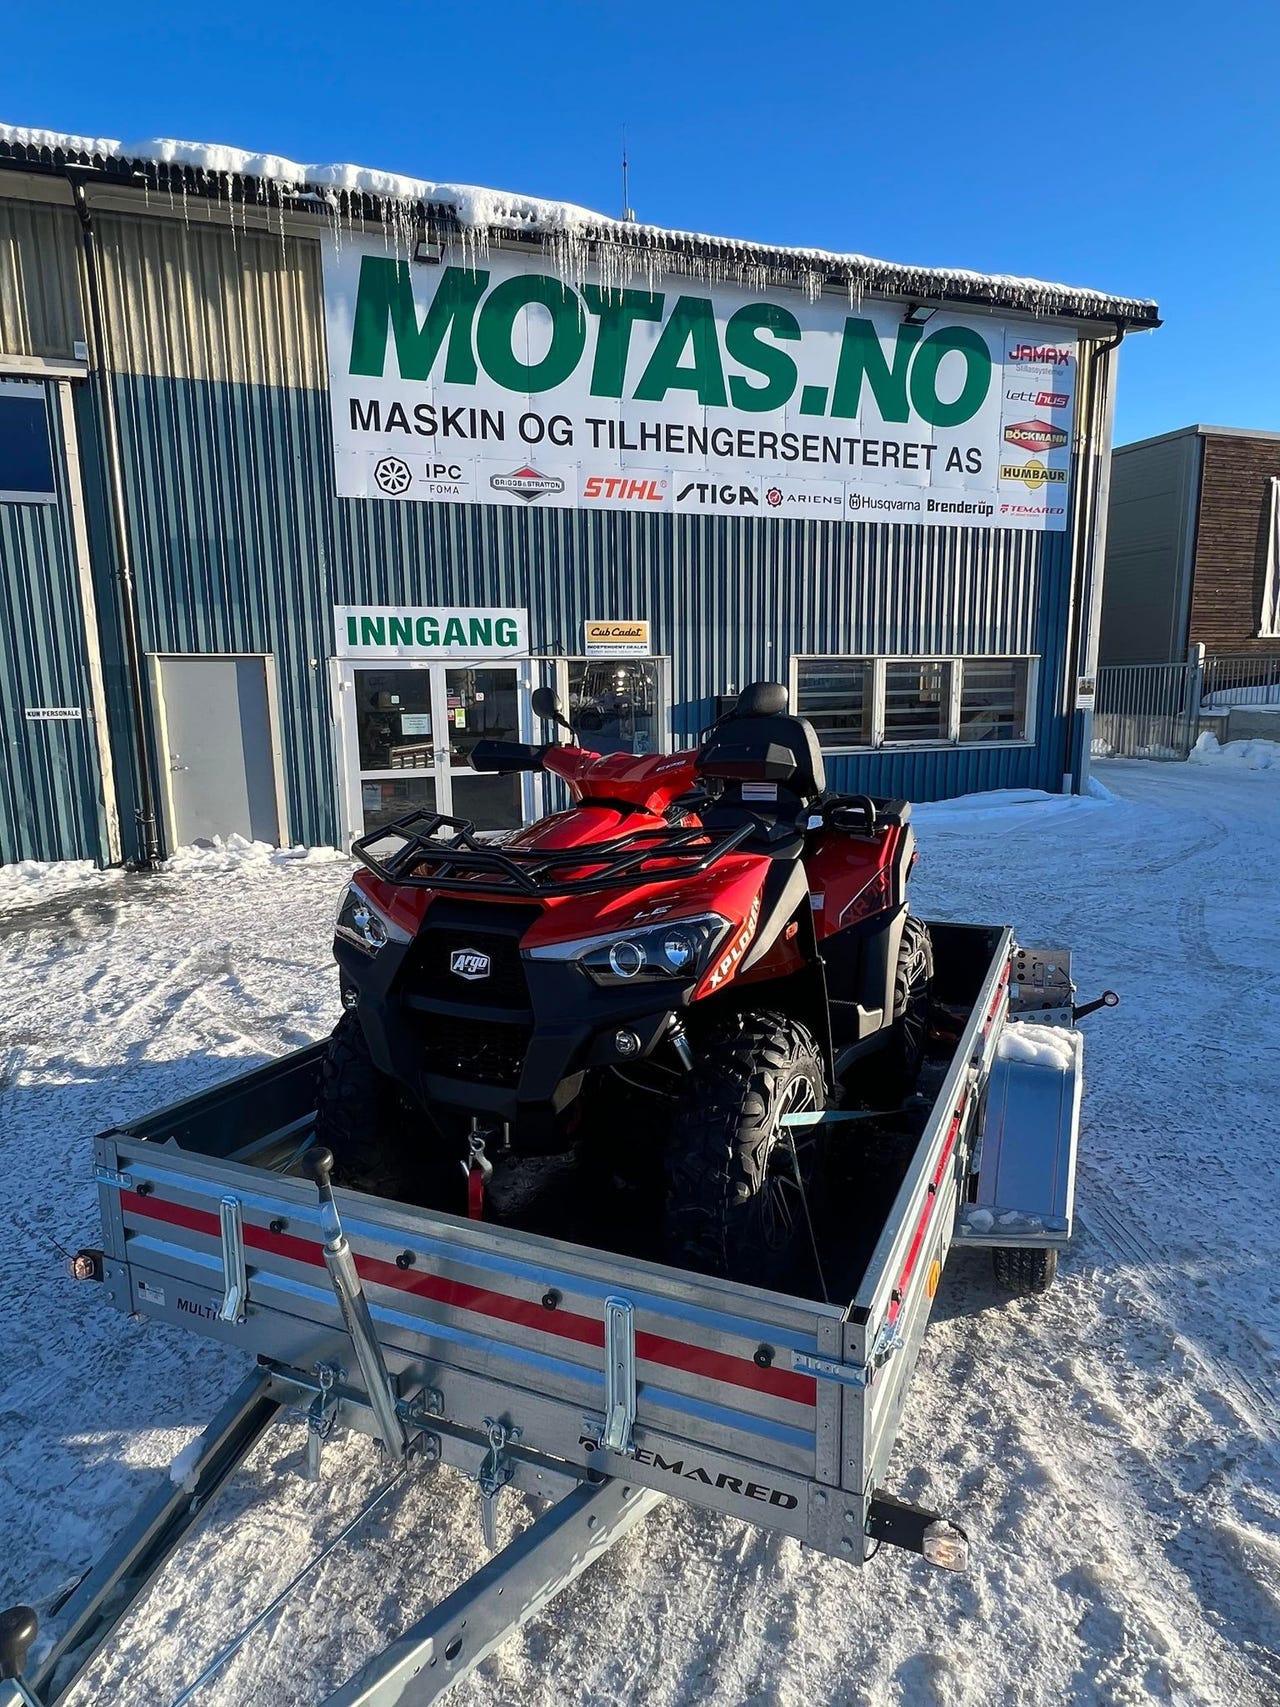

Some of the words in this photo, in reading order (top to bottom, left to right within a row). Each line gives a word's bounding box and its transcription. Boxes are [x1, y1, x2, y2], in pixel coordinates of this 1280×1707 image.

[349, 255, 992, 428] MOTAS.NO
[1008, 344, 1069, 366] JAMAX
[349, 398, 505, 441] MASKIN
[518, 412, 574, 447] OG
[585, 418, 938, 471] TILHENGERSENTERET
[945, 446, 983, 475] AS
[1005, 429, 1068, 444] BÖCKMANN
[425, 463, 462, 480] IPC
[1003, 467, 1065, 482] HUMBAUR
[429, 484, 460, 495] FOMA
[583, 477, 665, 501] STIHL
[676, 482, 759, 506] STIGA
[786, 493, 842, 505] ARIENS
[861, 496, 921, 513] Husqvarna
[926, 498, 994, 518] Brenderüp
[1010, 505, 1065, 515] TEMARED
[346, 615, 519, 647] INNGANG
[590, 627, 611, 637] Cub
[611, 627, 643, 637] Cadet
[42, 710, 80, 718] PERSONALE
[709, 895, 761, 989] XPLORER
[453, 954, 488, 973] Argo
[612, 1446, 799, 1510] EMARED
